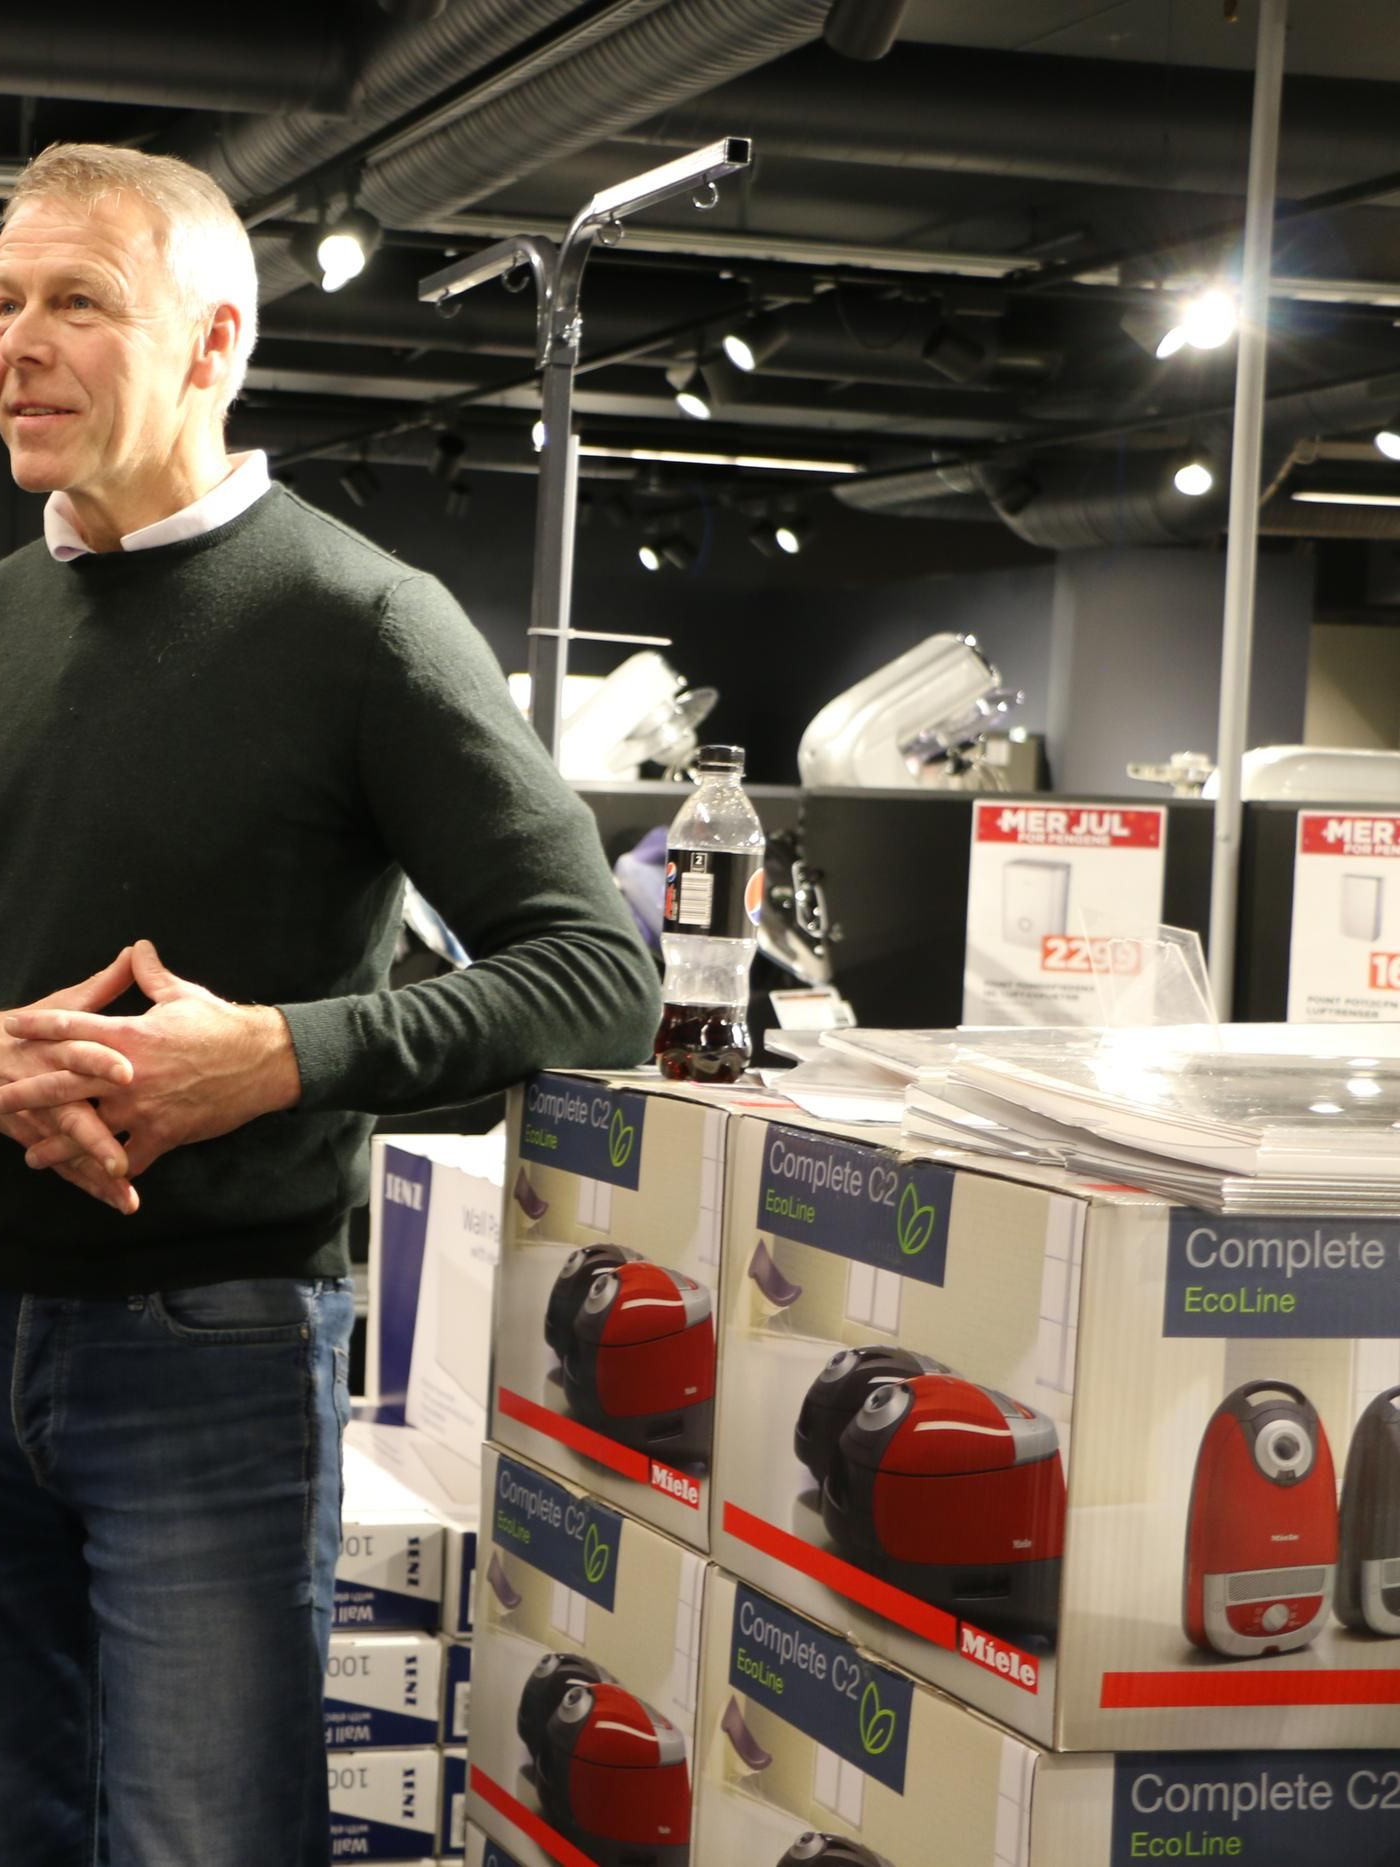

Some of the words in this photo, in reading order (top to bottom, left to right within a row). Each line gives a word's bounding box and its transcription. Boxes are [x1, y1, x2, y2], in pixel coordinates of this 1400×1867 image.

[1001, 809, 1068, 834] MER
[1072, 811, 1131, 837] JUL
[1327, 820, 1394, 845] MER
[695, 856, 702, 865] 2
[1046, 937, 1138, 971] 2299
[528, 1084, 588, 1125] Complete
[591, 1098, 611, 1130] C2
[770, 1141, 863, 1194] Complete
[868, 1166, 899, 1207] C2
[765, 1189, 816, 1224] EcoLine
[1185, 1228, 1385, 1279] Complete
[1184, 1286, 1296, 1313] EcoLine
[652, 1464, 698, 1504] Miele
[501, 1471, 562, 1529] Complete
[565, 1505, 585, 1541] C2
[337, 1535, 374, 1558] 10
[736, 1648, 785, 1694] EcoLine
[740, 1602, 827, 1680] Complete
[832, 1656, 861, 1701] C2
[962, 1628, 1036, 1687] Miele
[1131, 1772, 1333, 1821] Complete
[1347, 1770, 1400, 1810] C2
[1130, 1831, 1242, 1857] EcoLine
